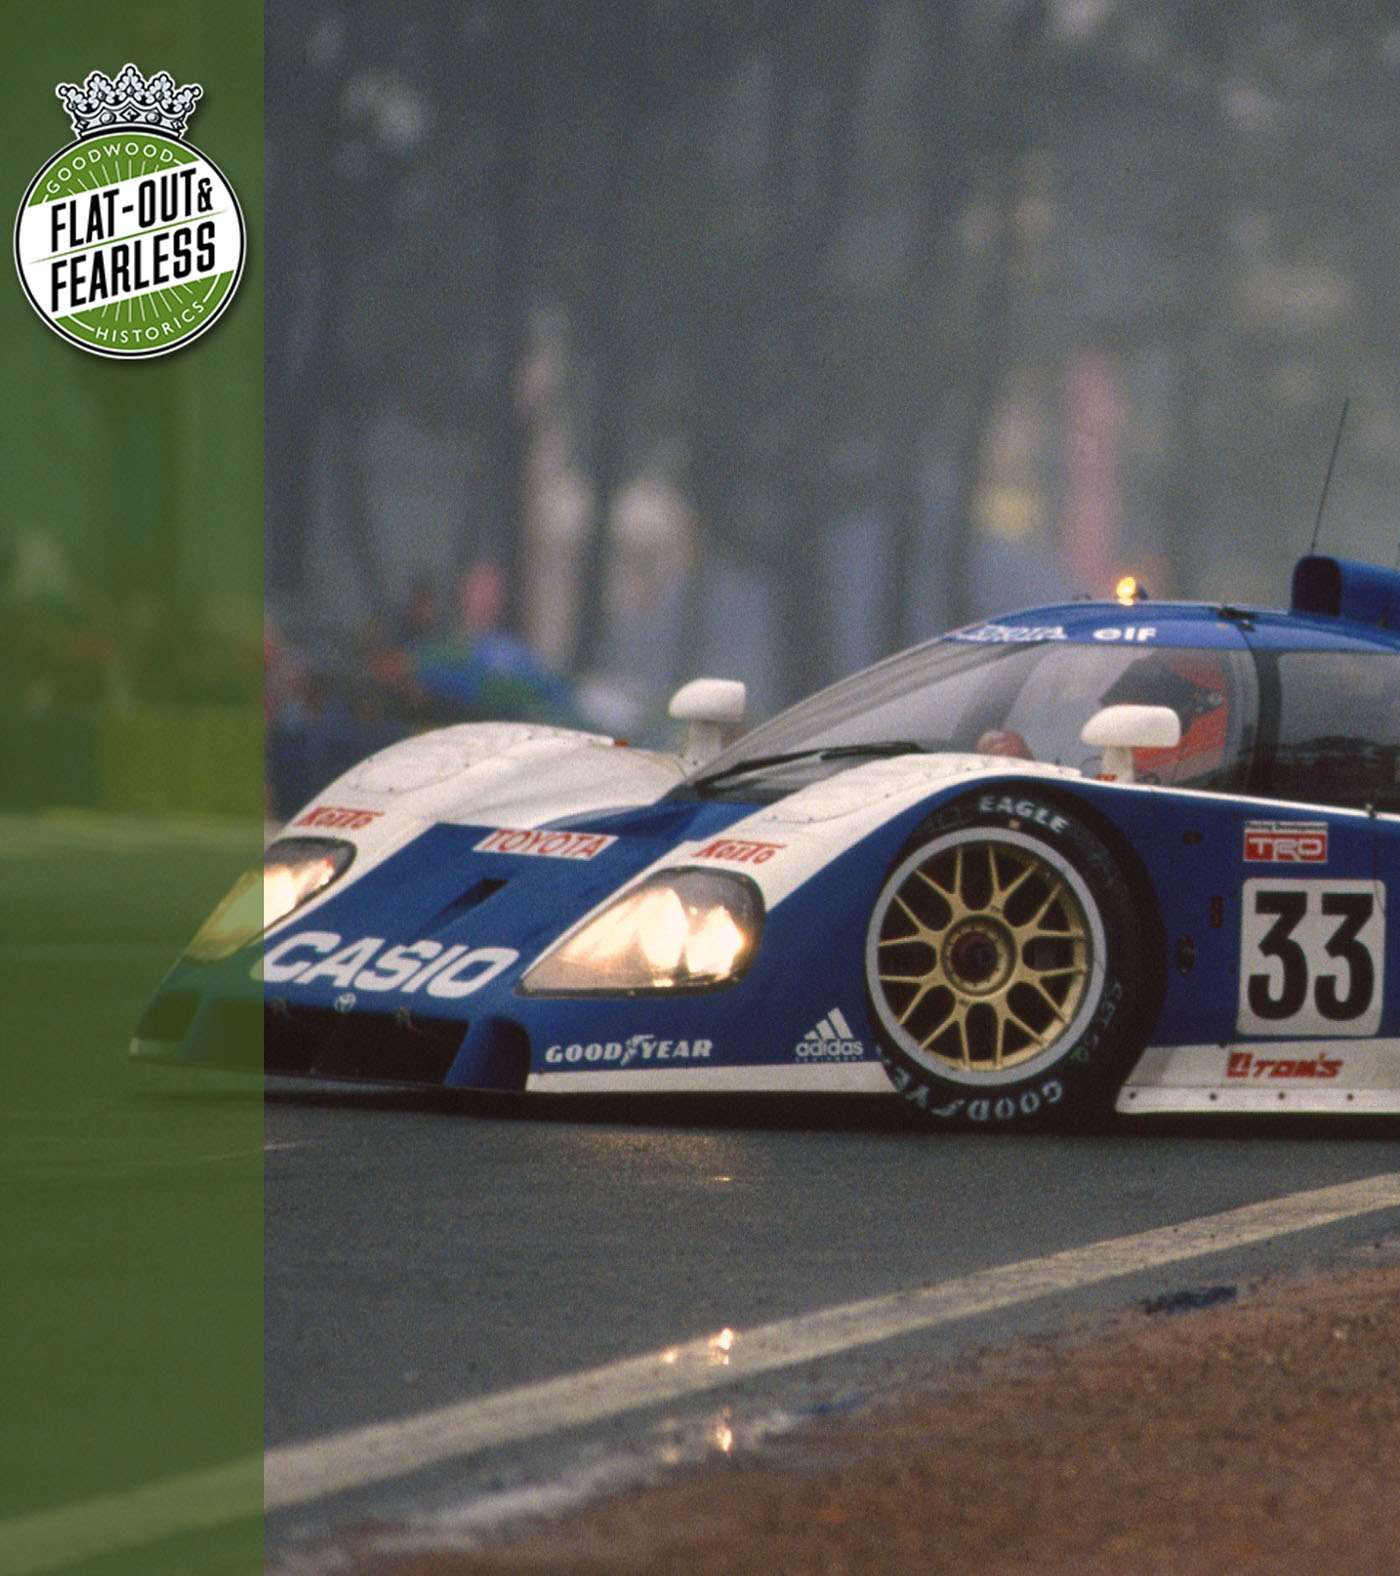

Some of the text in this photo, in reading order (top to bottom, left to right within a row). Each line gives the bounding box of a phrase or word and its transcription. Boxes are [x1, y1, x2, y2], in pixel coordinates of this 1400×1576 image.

[979, 795, 1071, 834] EAGLE
[482, 828, 611, 857] TOYOTA
[1248, 837, 1322, 862] TRD
[251, 931, 520, 999] CASIO
[1247, 891, 1376, 1022] 33
[545, 1033, 713, 1067] GOODYEAR
[796, 1039, 863, 1056] adidas
